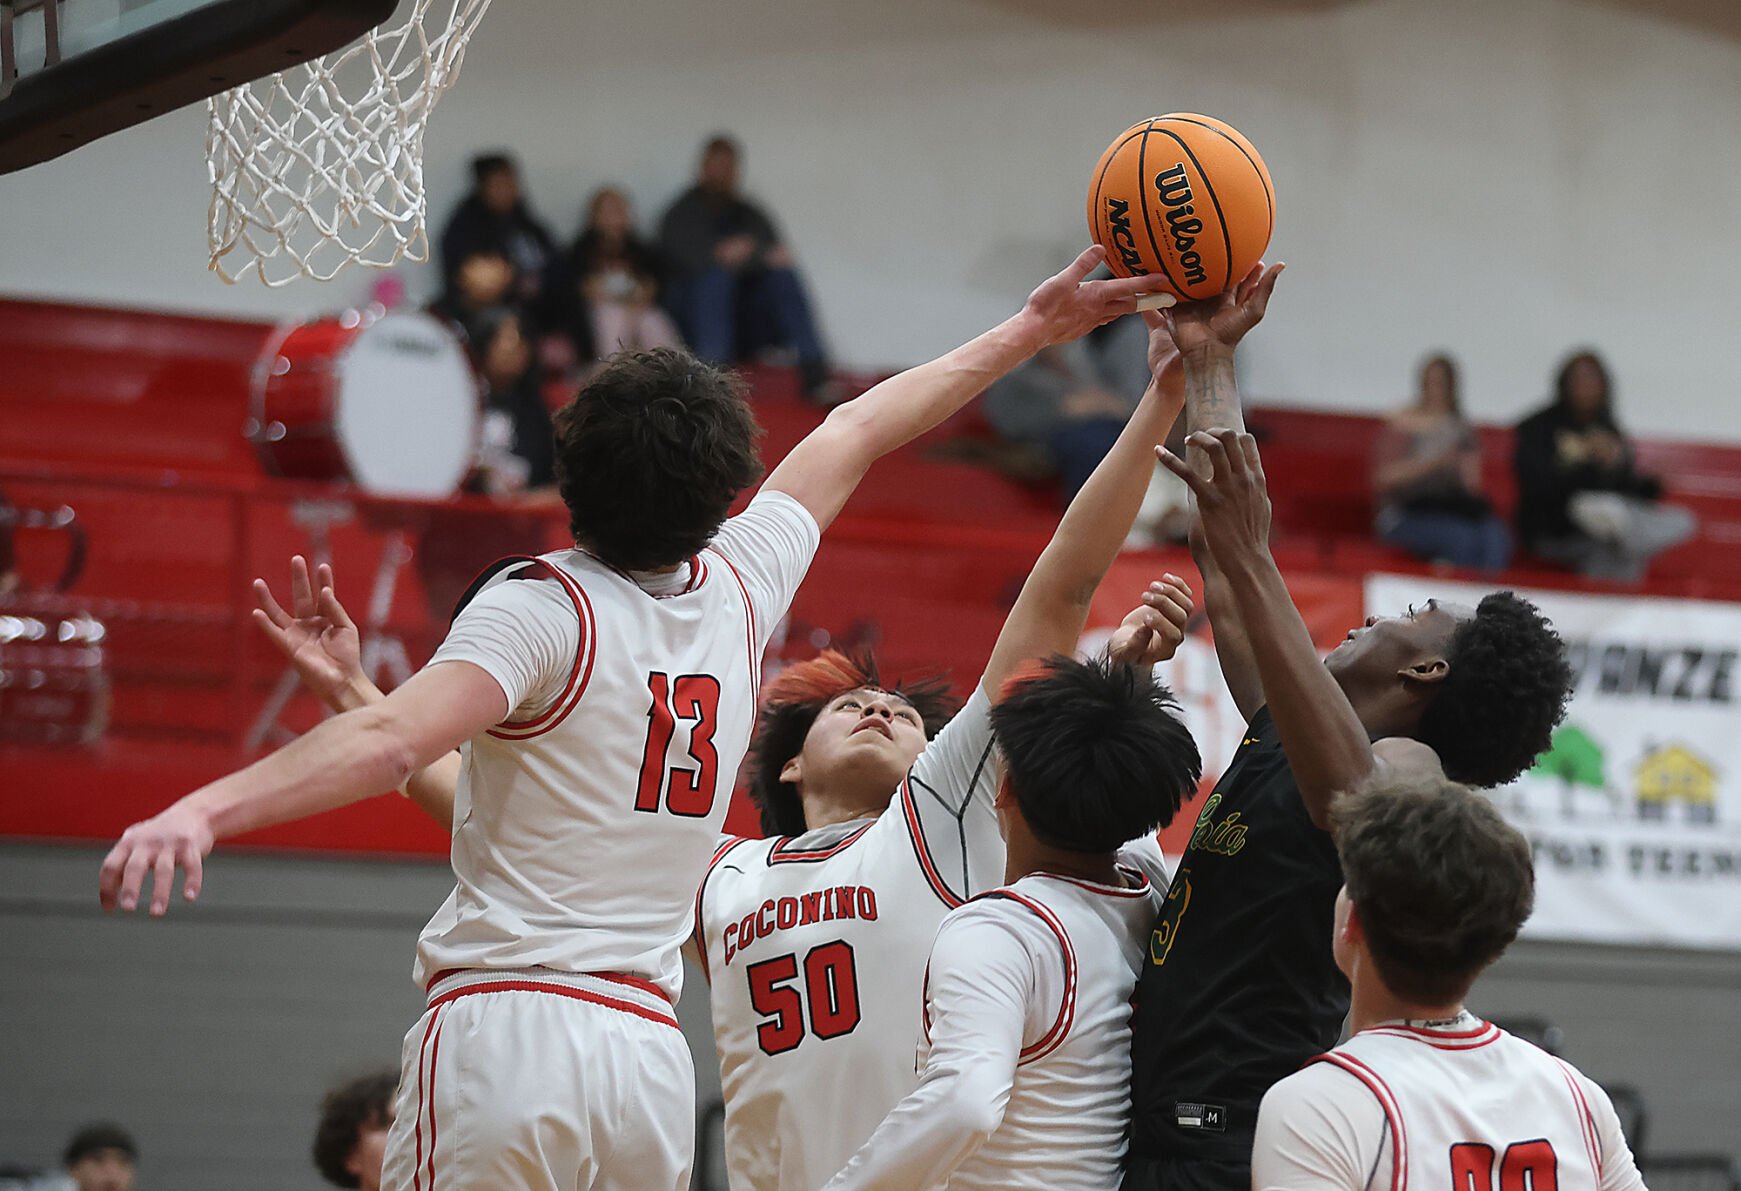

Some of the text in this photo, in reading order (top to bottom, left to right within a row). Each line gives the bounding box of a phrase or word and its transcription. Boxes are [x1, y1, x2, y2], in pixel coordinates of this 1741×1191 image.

[1154, 162, 1208, 287] Wilson
[633, 670, 721, 820] 13
[723, 885, 879, 967] COCONINO
[746, 938, 862, 1057] 50
